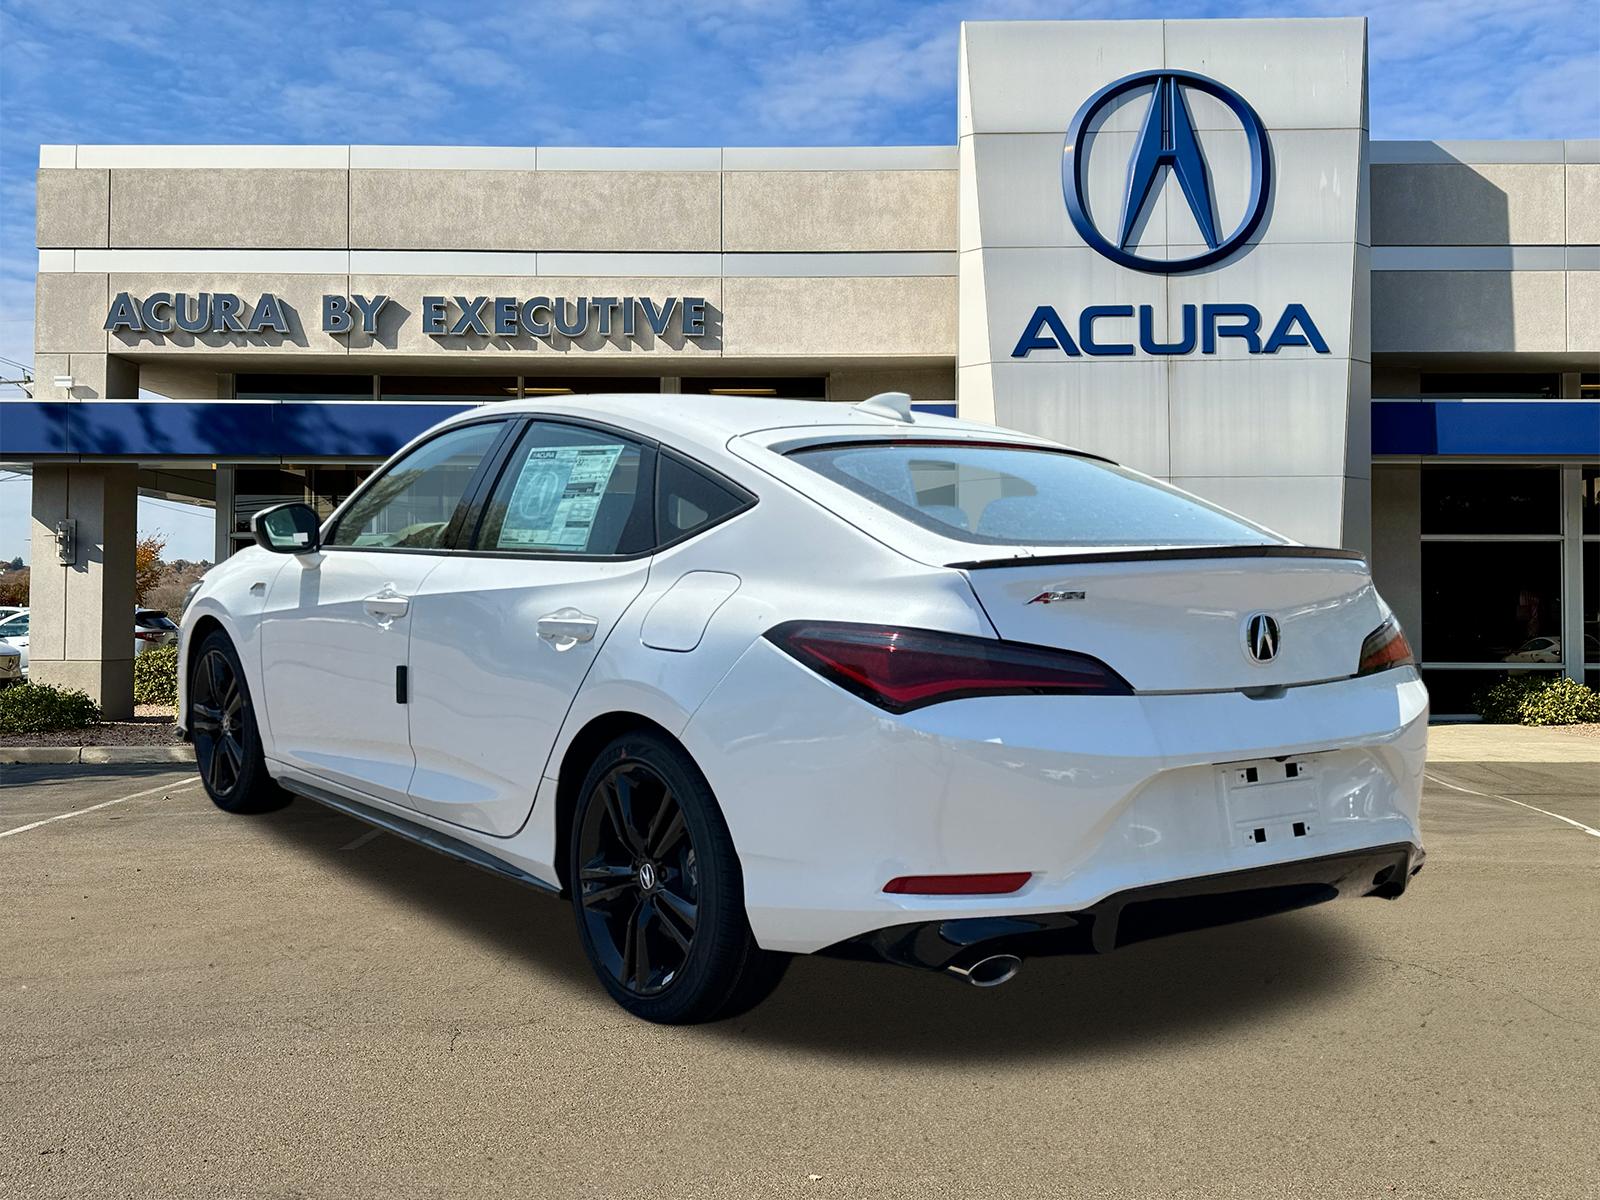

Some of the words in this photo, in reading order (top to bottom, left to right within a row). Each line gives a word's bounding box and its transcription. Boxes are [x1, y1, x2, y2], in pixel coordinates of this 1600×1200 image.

[104, 292, 289, 334] ACURA
[322, 294, 391, 335] BY
[423, 296, 706, 338] EXECUTIVE
[1011, 303, 1331, 357] ACURA
